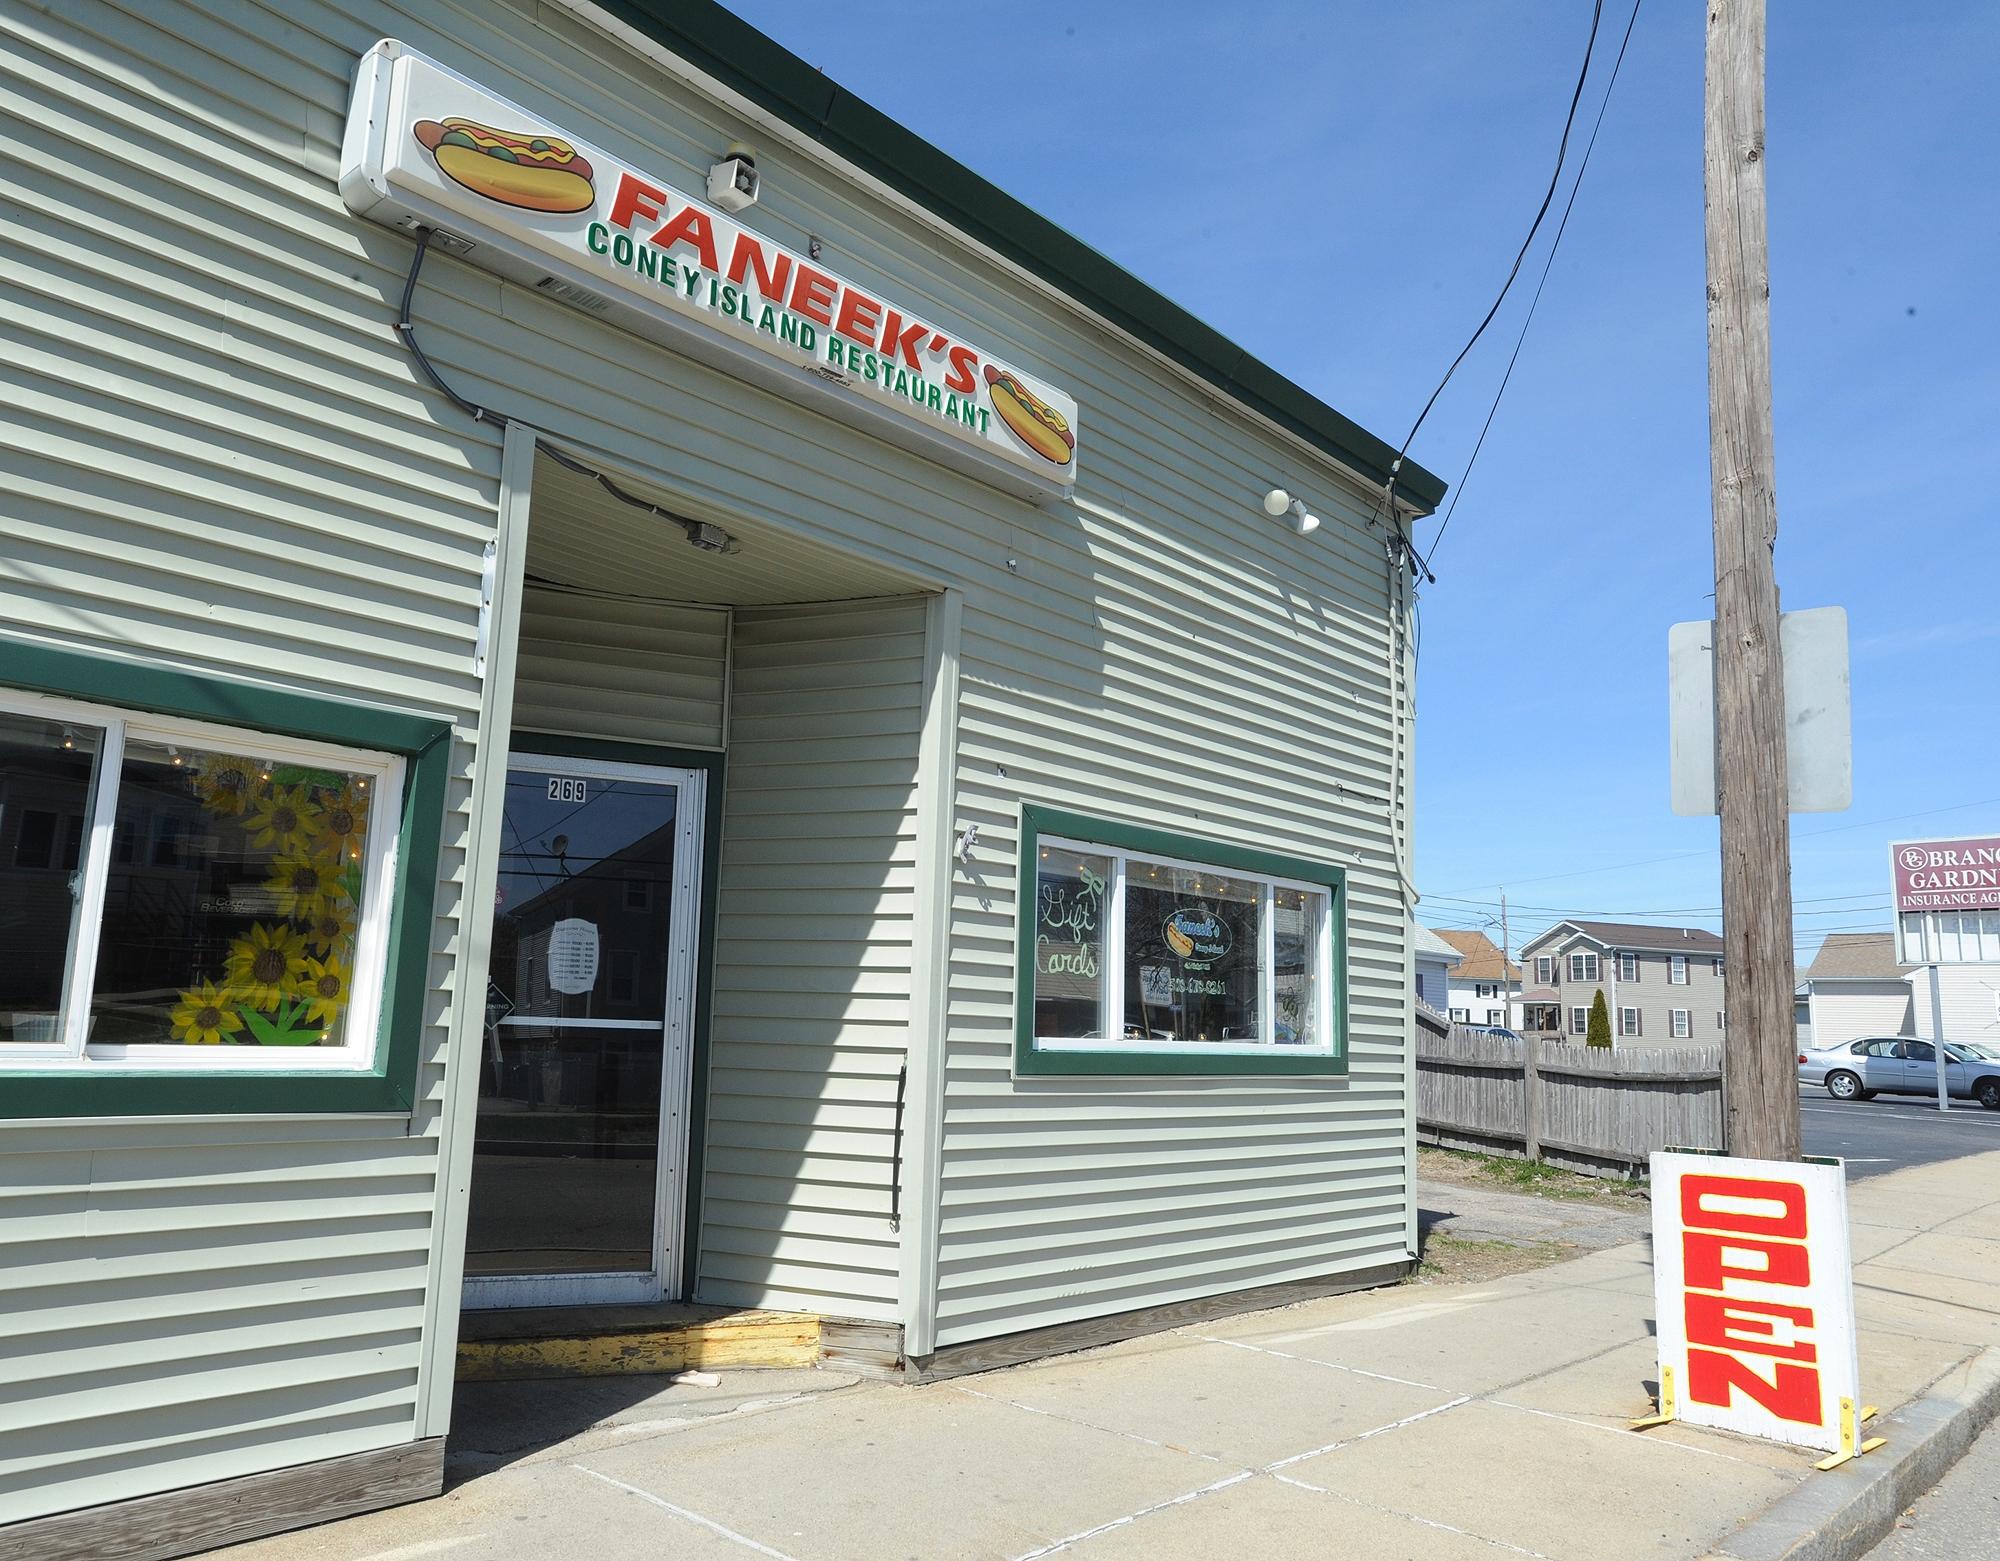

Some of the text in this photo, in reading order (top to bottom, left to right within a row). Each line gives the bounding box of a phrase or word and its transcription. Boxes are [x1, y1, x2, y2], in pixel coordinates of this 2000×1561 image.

[609, 172, 978, 394] FANEEK'S
[587, 221, 700, 297] CONEY
[708, 278, 816, 351] ISLAND
[828, 335, 990, 433] RESTAURANT
[549, 780, 585, 801] 269
[1903, 891, 2000, 906] INSURANCE AG
[1909, 868, 2000, 889] GARDN
[1041, 884, 1096, 943] Gift
[1037, 934, 1099, 978] Cards
[1680, 1174, 1825, 1427] OPEN
